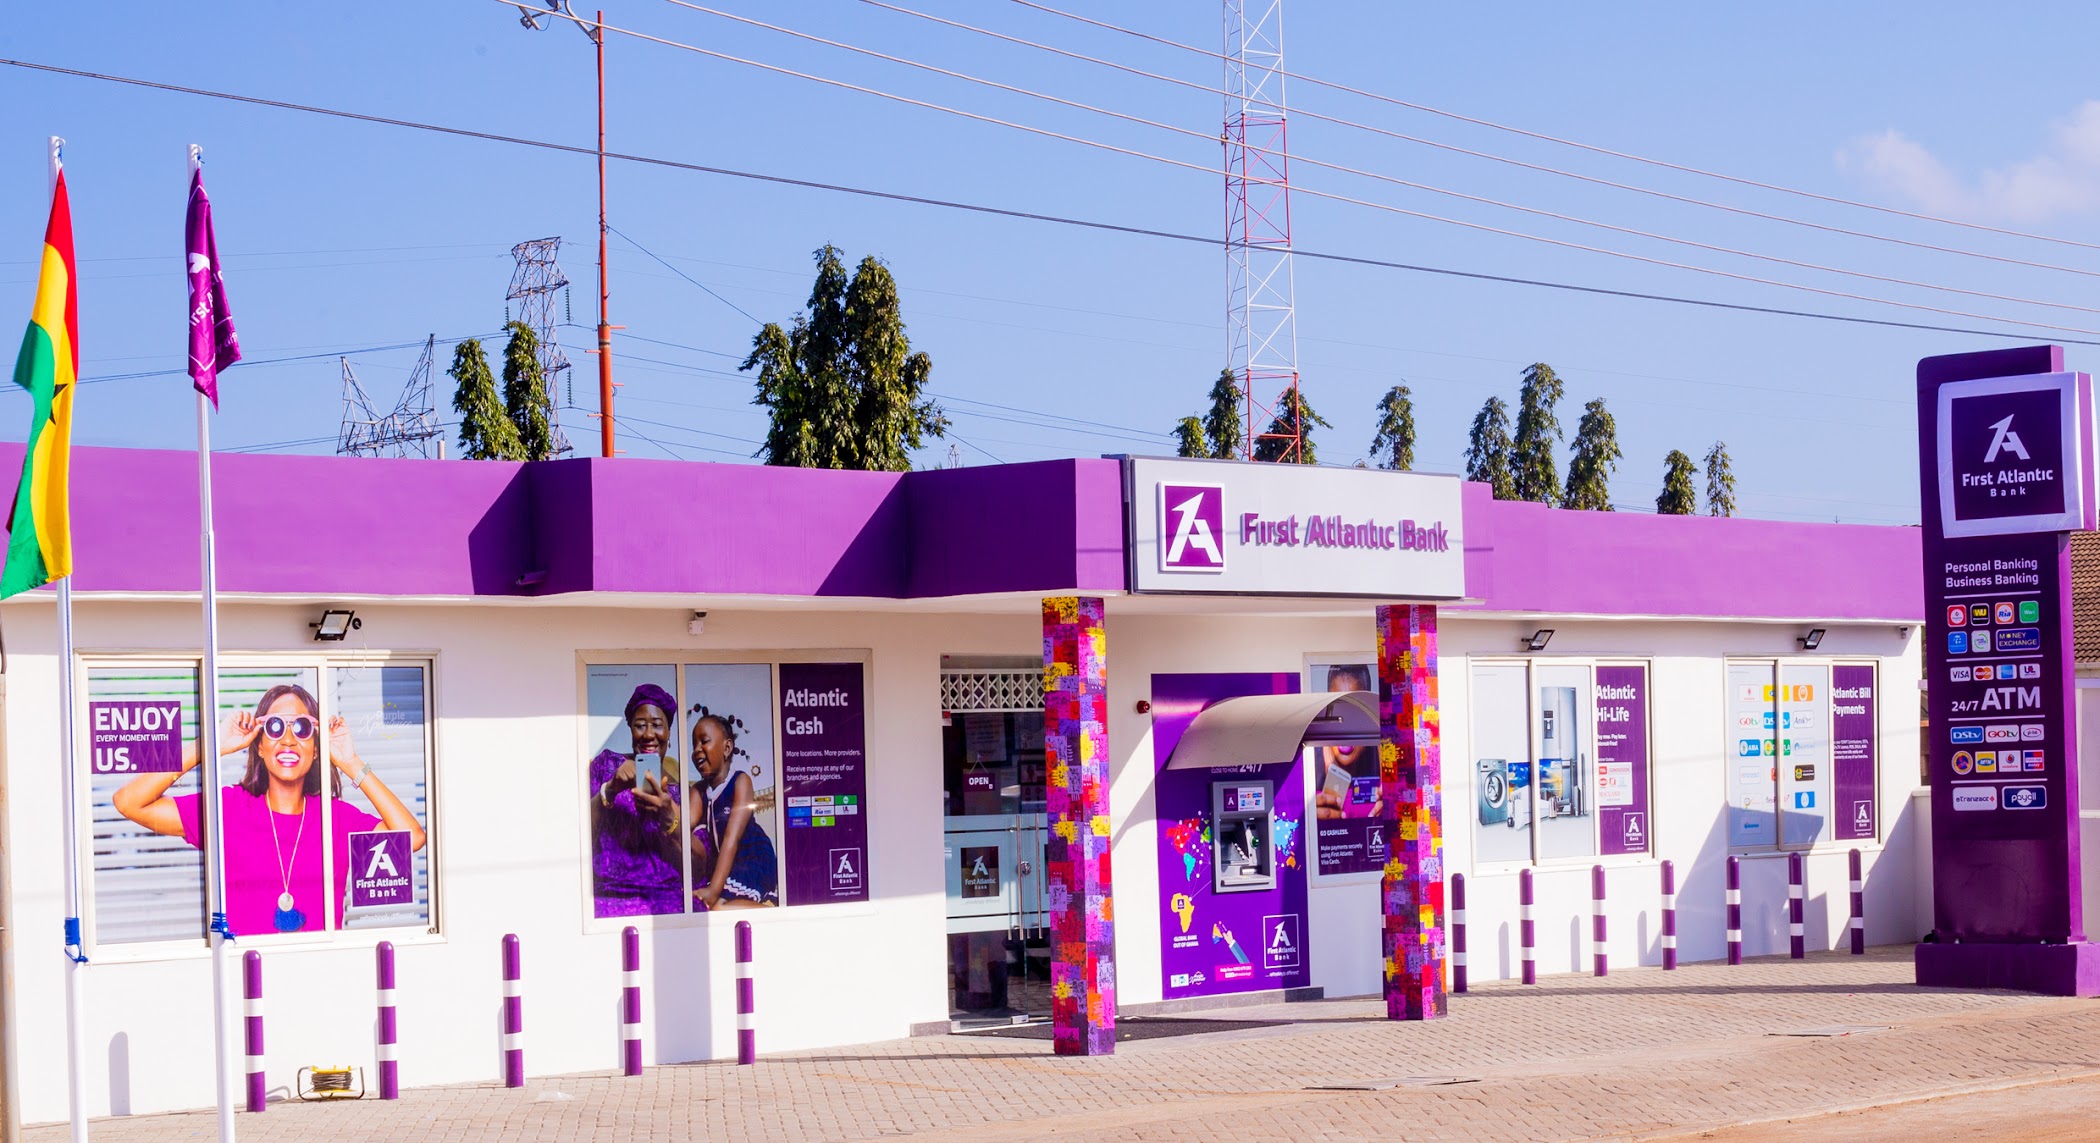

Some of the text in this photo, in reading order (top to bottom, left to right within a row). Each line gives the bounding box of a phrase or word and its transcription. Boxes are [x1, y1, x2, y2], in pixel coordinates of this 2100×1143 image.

[190, 301, 211, 326] irst
[1961, 467, 2054, 487] First Atlantic
[1990, 486, 2026, 497] Bank
[1240, 512, 1449, 552] First Atlantic Bank
[1945, 557, 2038, 573] Personal Banking
[1945, 573, 2039, 588] Business Banking
[1998, 608, 2011, 617] Ria
[1998, 639, 2037, 647] EXCHANGE
[1952, 670, 1970, 679] VISA
[784, 688, 849, 707] Atlantic
[1596, 684, 1636, 700] Atlantic
[1832, 687, 1871, 699] Atlantic Bill
[1951, 686, 2041, 712] 24/7 ATM
[1596, 706, 1630, 722] Hi-Life
[1832, 704, 1866, 717] Payments
[95, 707, 179, 731] ENJOY
[785, 716, 823, 735] Cash
[95, 733, 169, 742] EVERY MOMENT WITH
[1953, 731, 1981, 739] DStv
[1987, 730, 2018, 738] GOtv
[96, 747, 137, 772] US.
[800, 749, 823, 757] locations.
[837, 749, 861, 757] providers.
[968, 777, 989, 785] OPEN
[356, 876, 408, 889] First Atlantic
[369, 887, 397, 898] Bank
